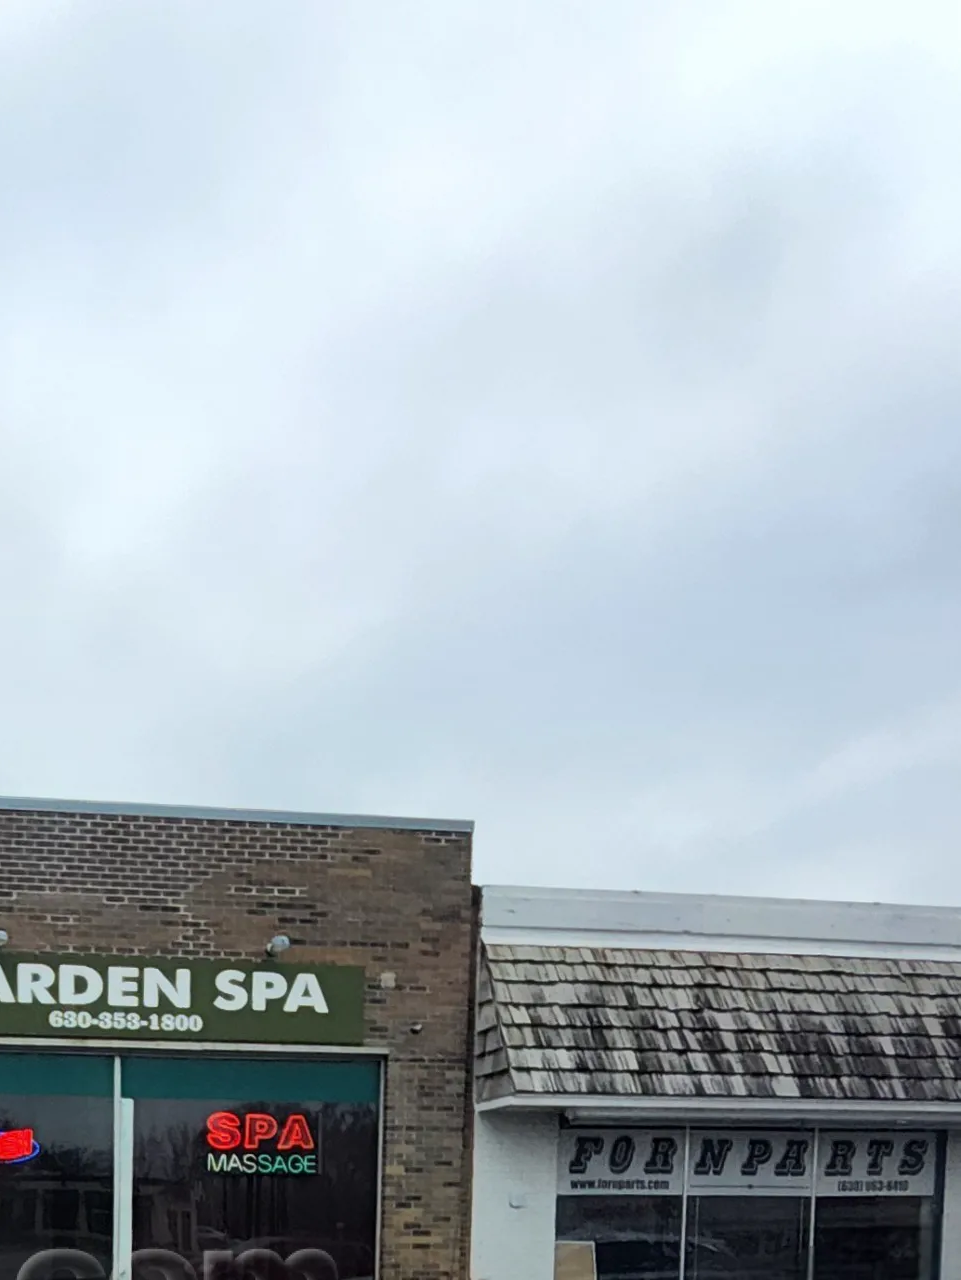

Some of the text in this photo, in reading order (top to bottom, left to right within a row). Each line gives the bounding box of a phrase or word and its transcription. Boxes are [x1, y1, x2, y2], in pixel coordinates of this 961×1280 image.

[212, 969, 329, 1014] SPA
[48, 1009, 204, 1032] 630-353-1800
[206, 1112, 315, 1149] SPA
[207, 1153, 317, 1173] MASSAGE
